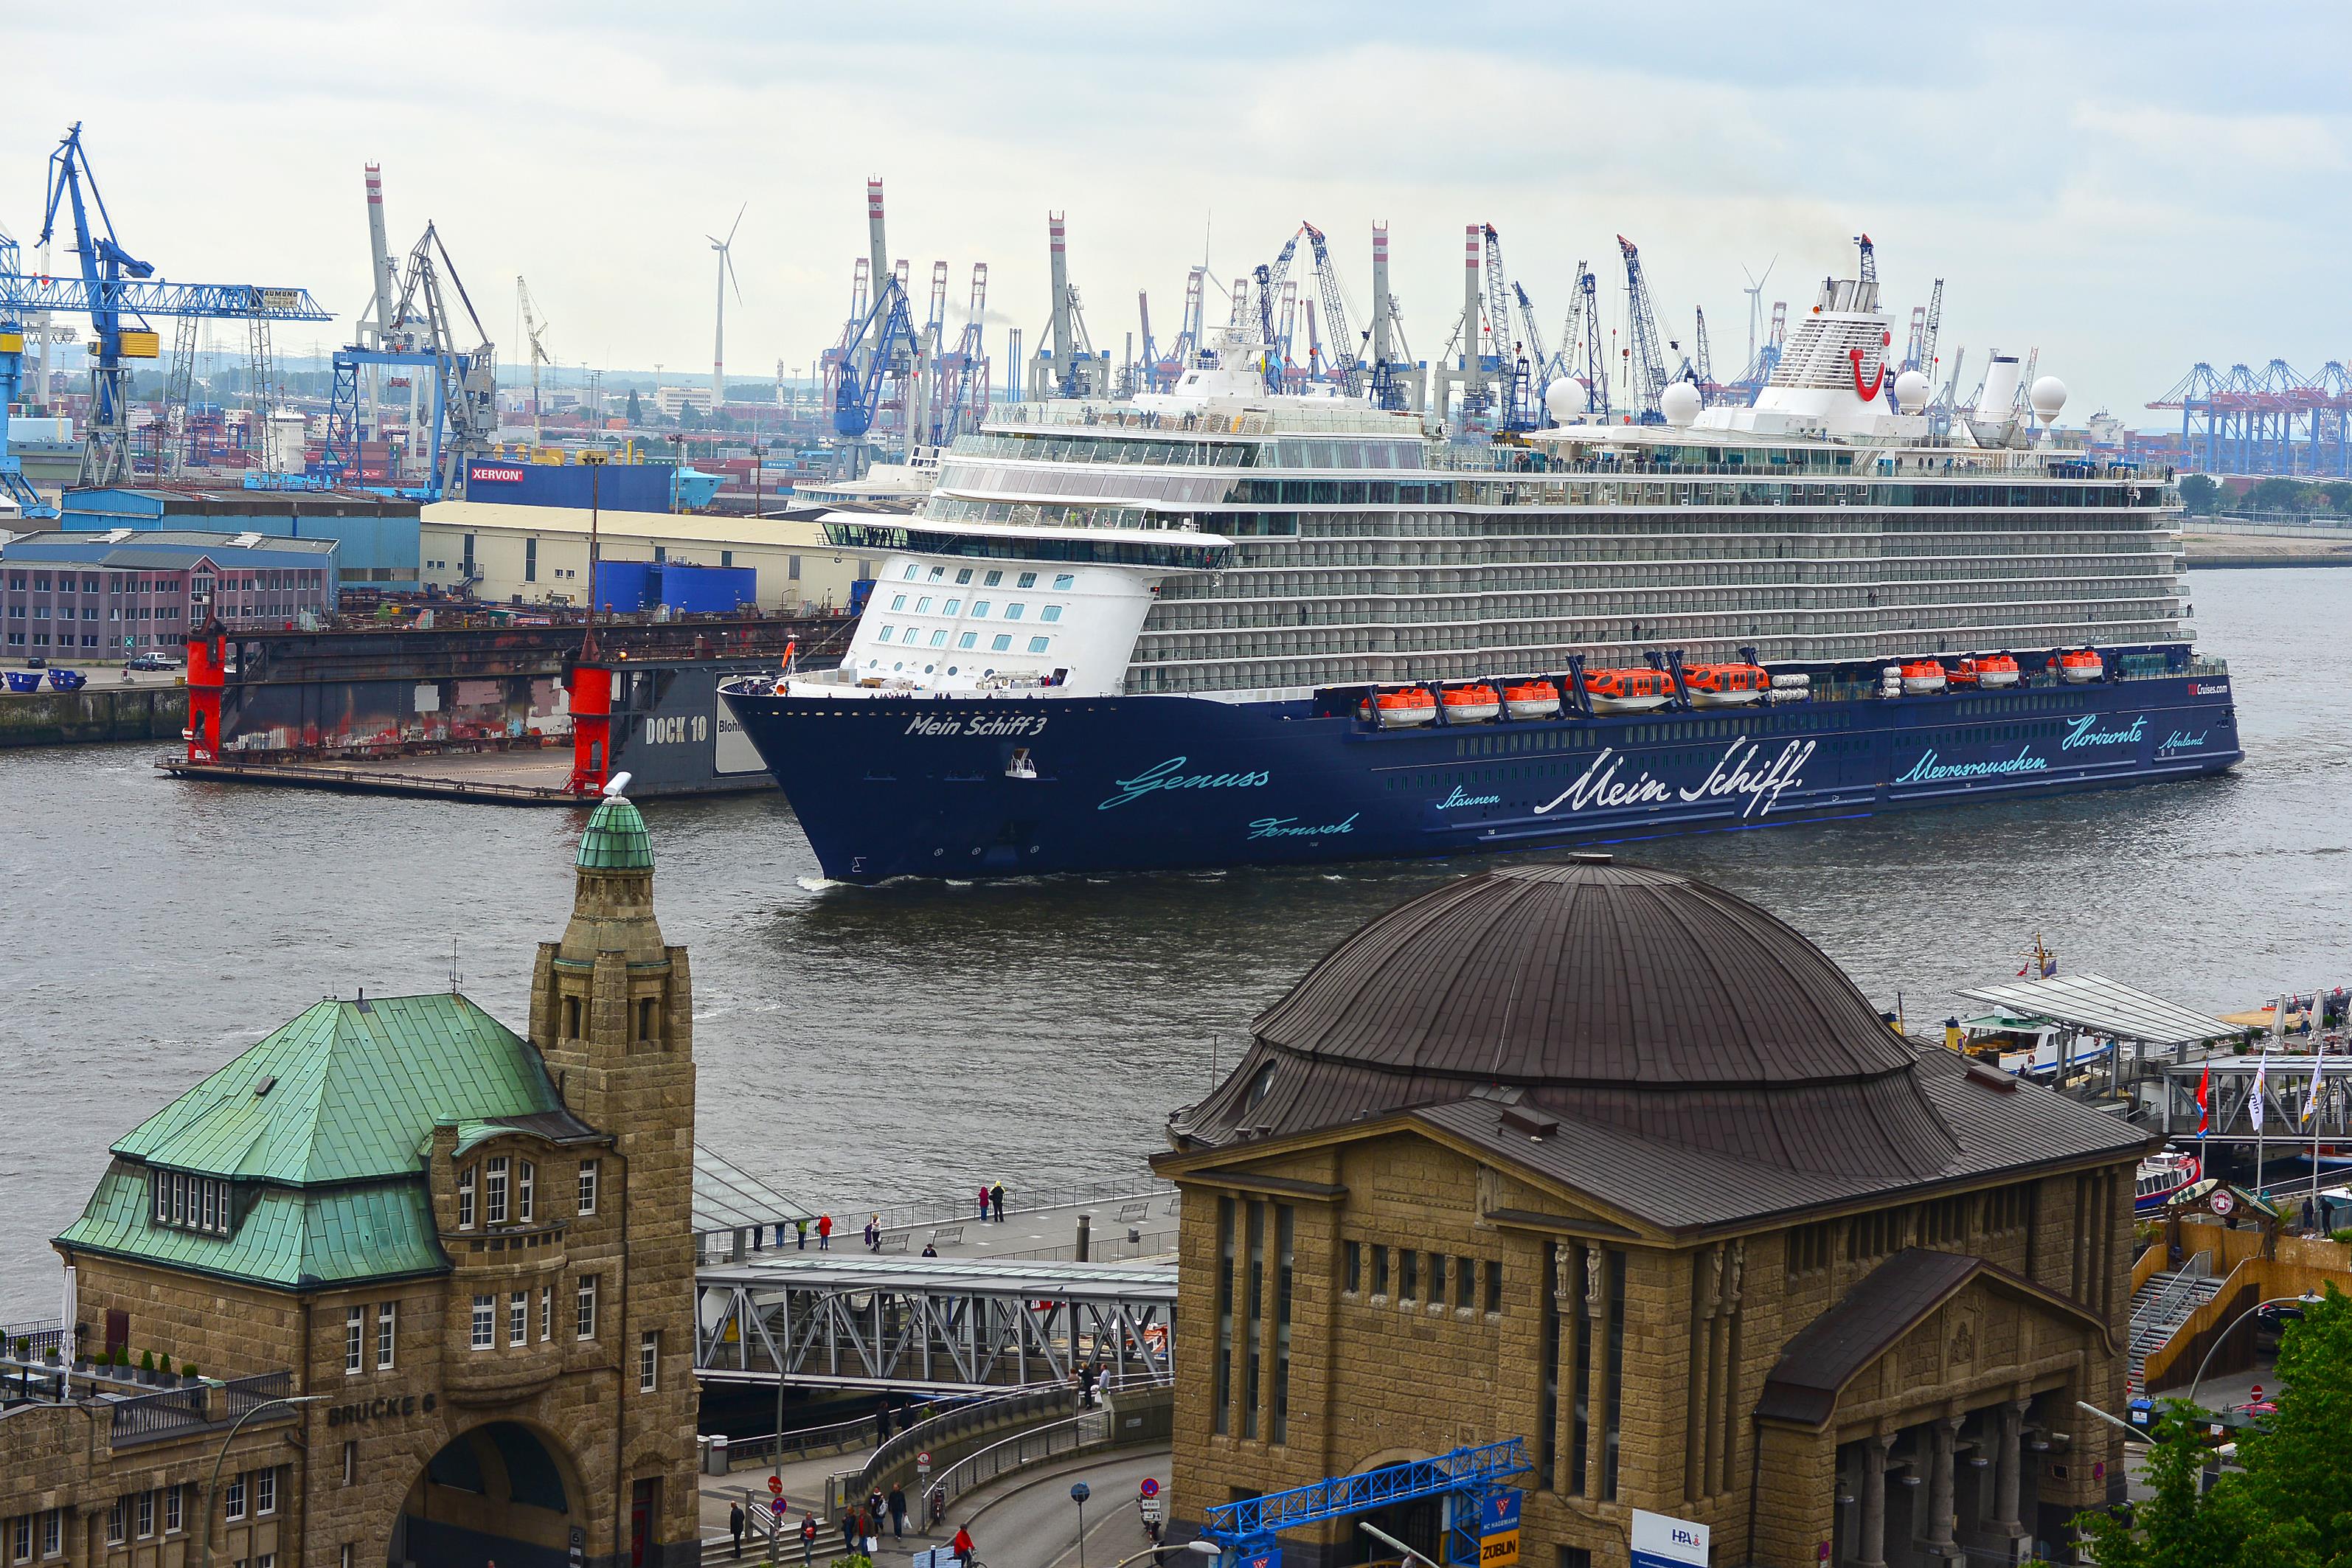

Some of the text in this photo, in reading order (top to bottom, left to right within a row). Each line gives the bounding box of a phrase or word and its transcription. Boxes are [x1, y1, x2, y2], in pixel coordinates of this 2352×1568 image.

[473, 469, 519, 480] XERVON
[645, 715, 707, 745] DOCK 10
[904, 716, 1047, 736] Mein Schiff 3
[1097, 756, 1269, 811] Genuss
[1533, 747, 1671, 814] Mein
[1672, 1528, 1693, 1545] HPA
